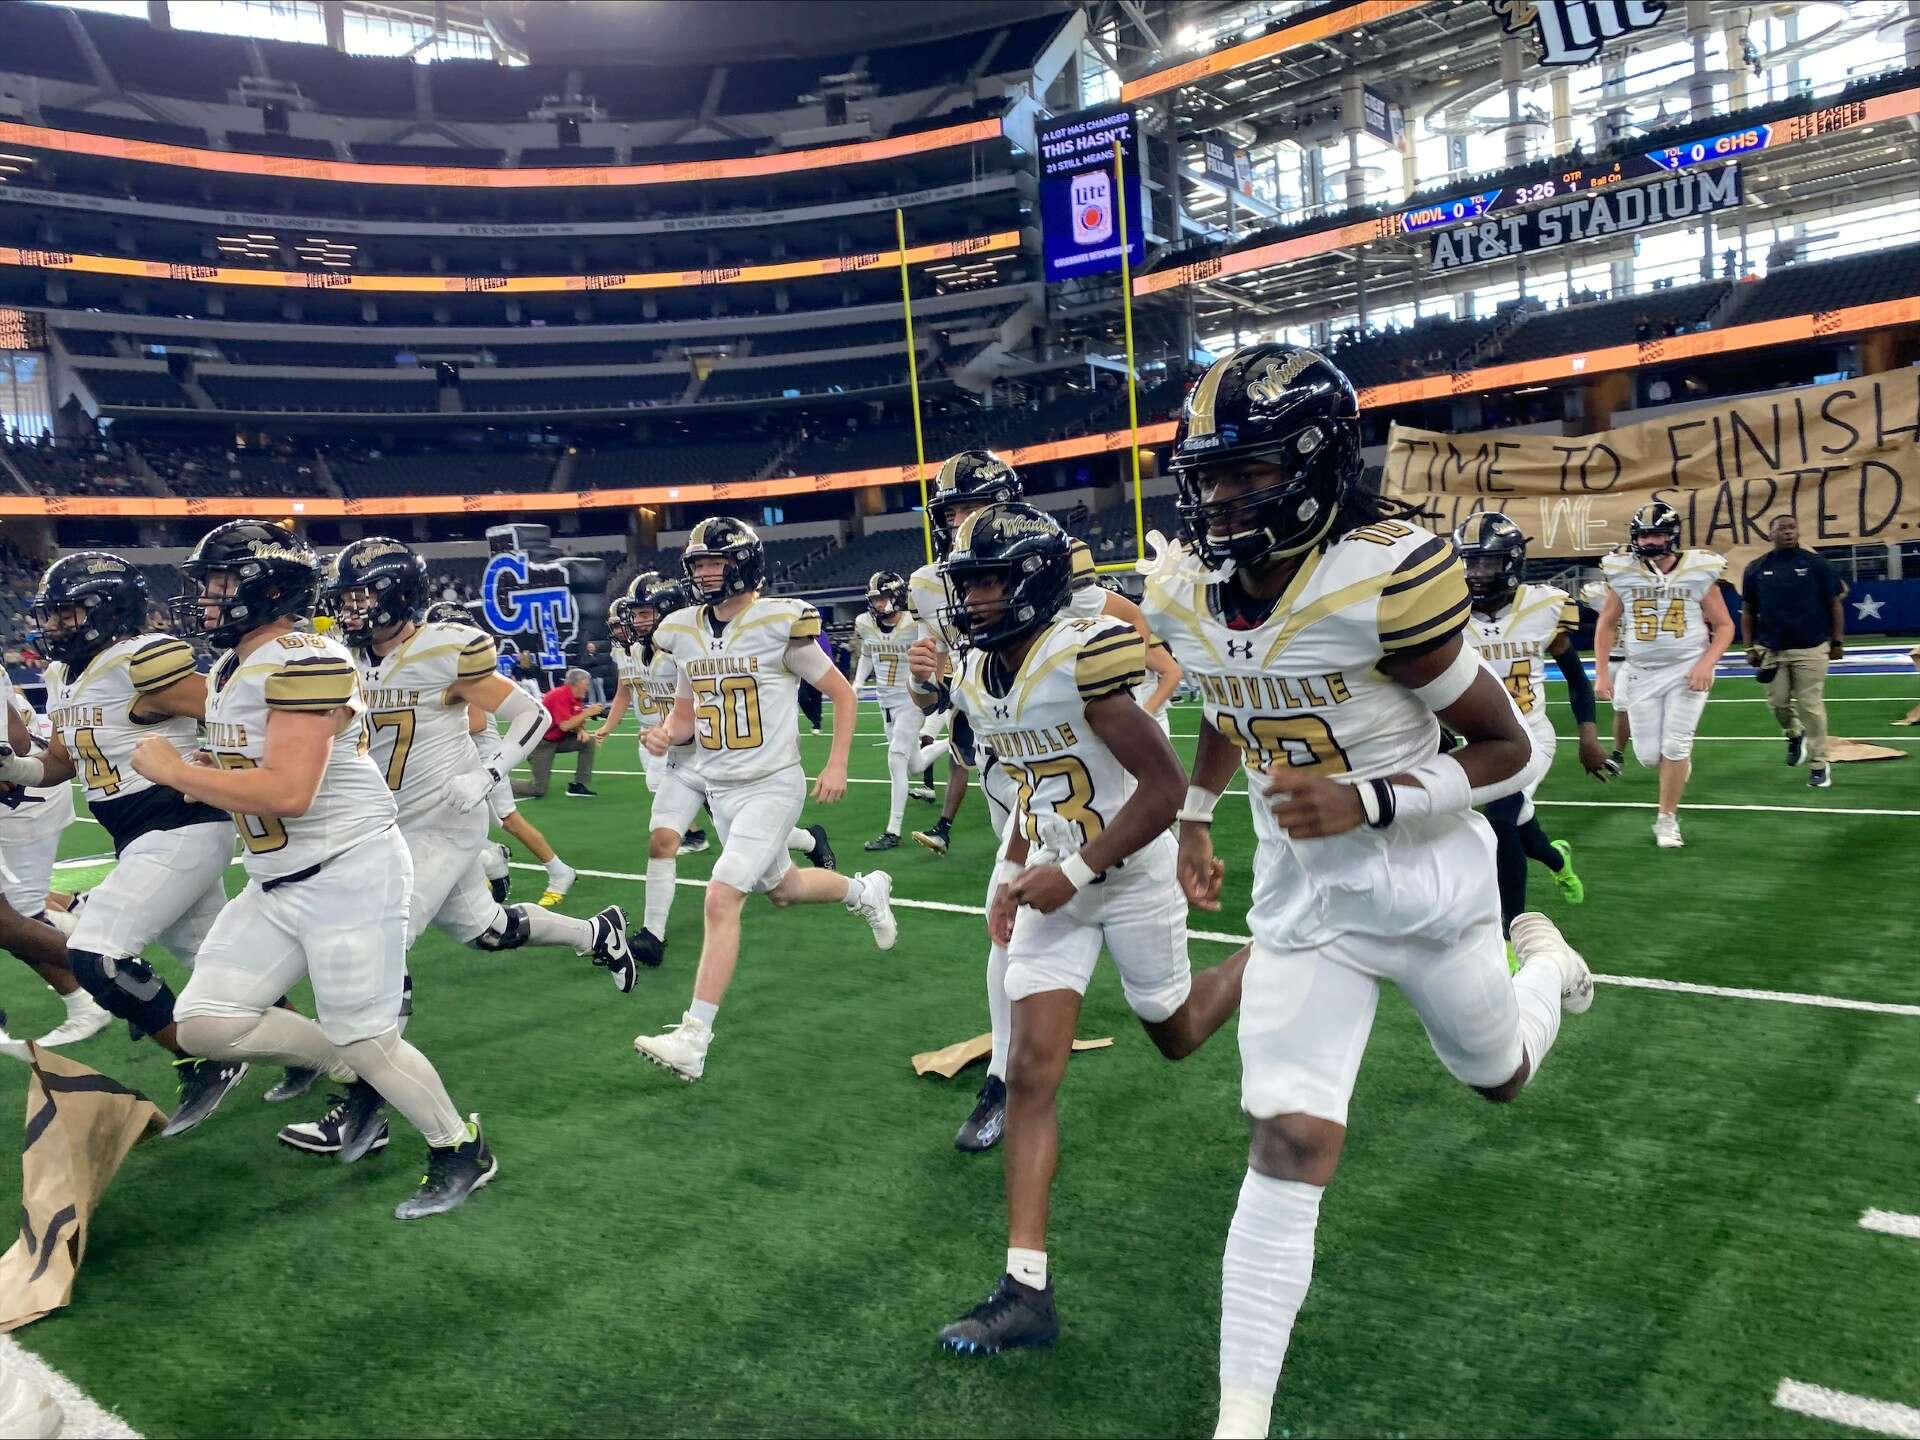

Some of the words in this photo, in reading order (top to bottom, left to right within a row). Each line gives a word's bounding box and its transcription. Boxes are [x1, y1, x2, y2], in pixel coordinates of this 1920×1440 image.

[1042, 132, 1052, 142] A
[1051, 128, 1068, 140] LOT
[1066, 124, 1086, 137] HAS
[1086, 113, 1130, 133] CHANGED
[1042, 140, 1074, 158] THIS
[1076, 126, 1132, 150] HASN'T.
[1058, 156, 1083, 171] STILL
[1083, 149, 1115, 165] MEANS
[1691, 143, 1705, 161] 0
[1715, 130, 1759, 154] GHS
[1670, 157, 1679, 168] 3
[1074, 184, 1106, 205] Lite
[1515, 181, 1556, 204] 3:26
[1590, 176, 1608, 187] Ball
[1608, 173, 1622, 184] On
[1409, 206, 1446, 227] WDVL
[1453, 202, 1465, 218] 0
[1432, 213, 1529, 271] AT&T
[1538, 165, 1740, 247] STADIUM
[1398, 438, 1521, 492] TIME
[1552, 443, 1622, 491] TO
[1667, 374, 1920, 487] FINISH
[1539, 491, 1624, 551] WE
[481, 550, 573, 670] GT
[1632, 598, 1688, 641] 64
[879, 653, 899, 688] 7
[691, 675, 764, 751] 50
